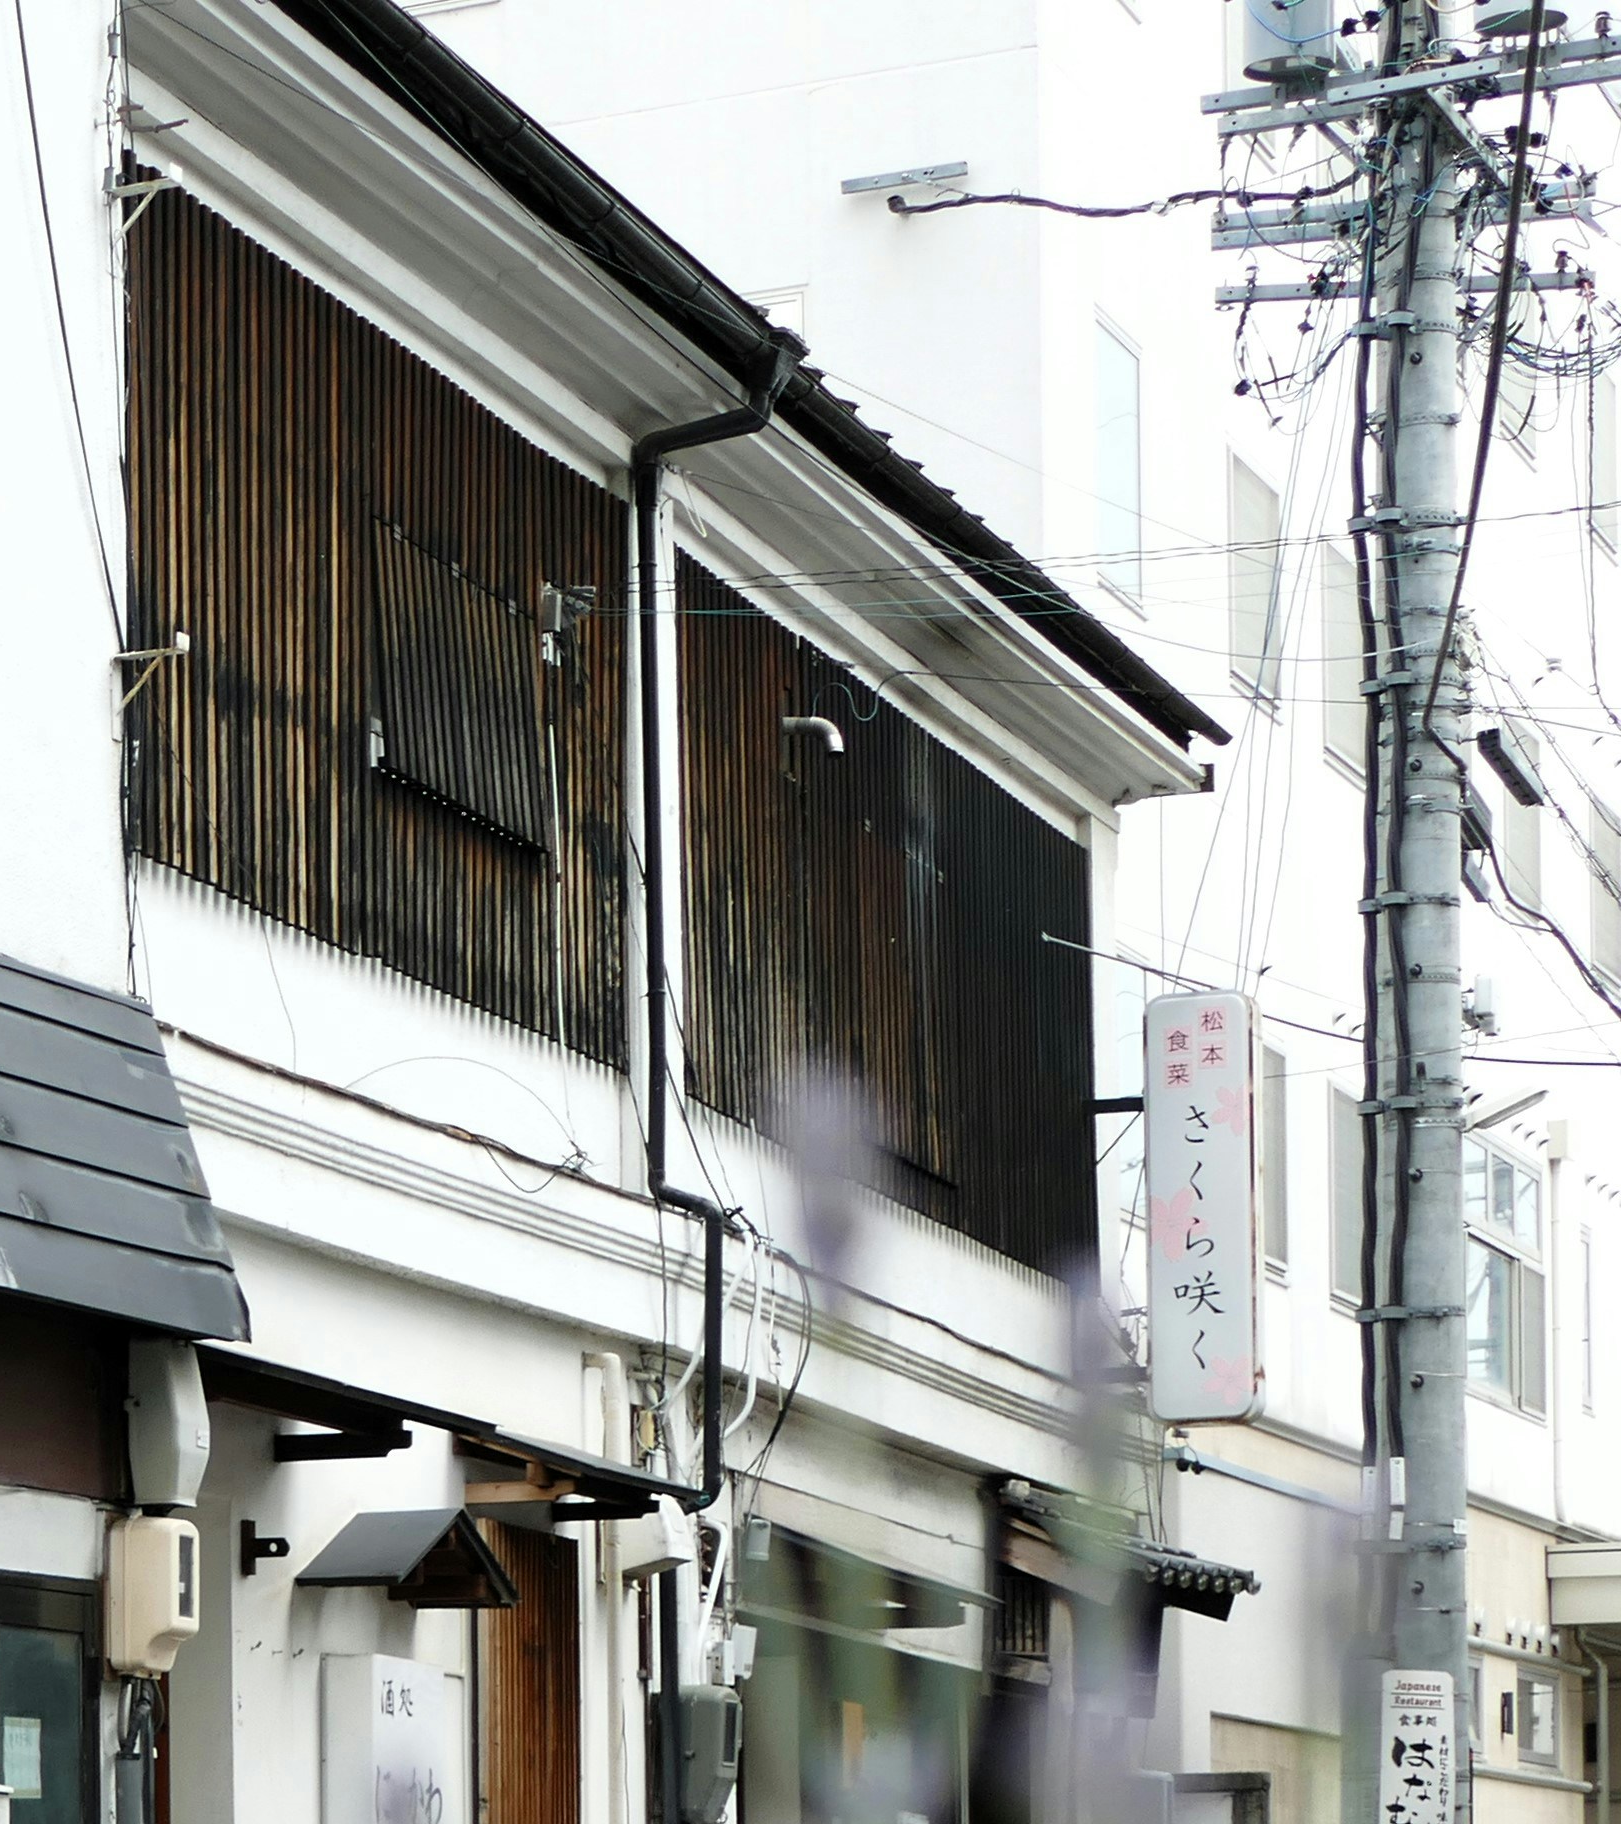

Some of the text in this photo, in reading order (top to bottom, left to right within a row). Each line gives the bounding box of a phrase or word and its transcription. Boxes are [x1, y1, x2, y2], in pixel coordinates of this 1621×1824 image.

[1199, 1009, 1225, 1066] 松本
[1166, 1029, 1192, 1086] 食菜
[1172, 1104, 1226, 1371] さくら咲く
[380, 1679, 414, 1718] 酒処
[1394, 1679, 1442, 1693] Japanese
[1394, 1695, 1443, 1707] Restaurant
[1398, 1713, 1438, 1728] 食事処
